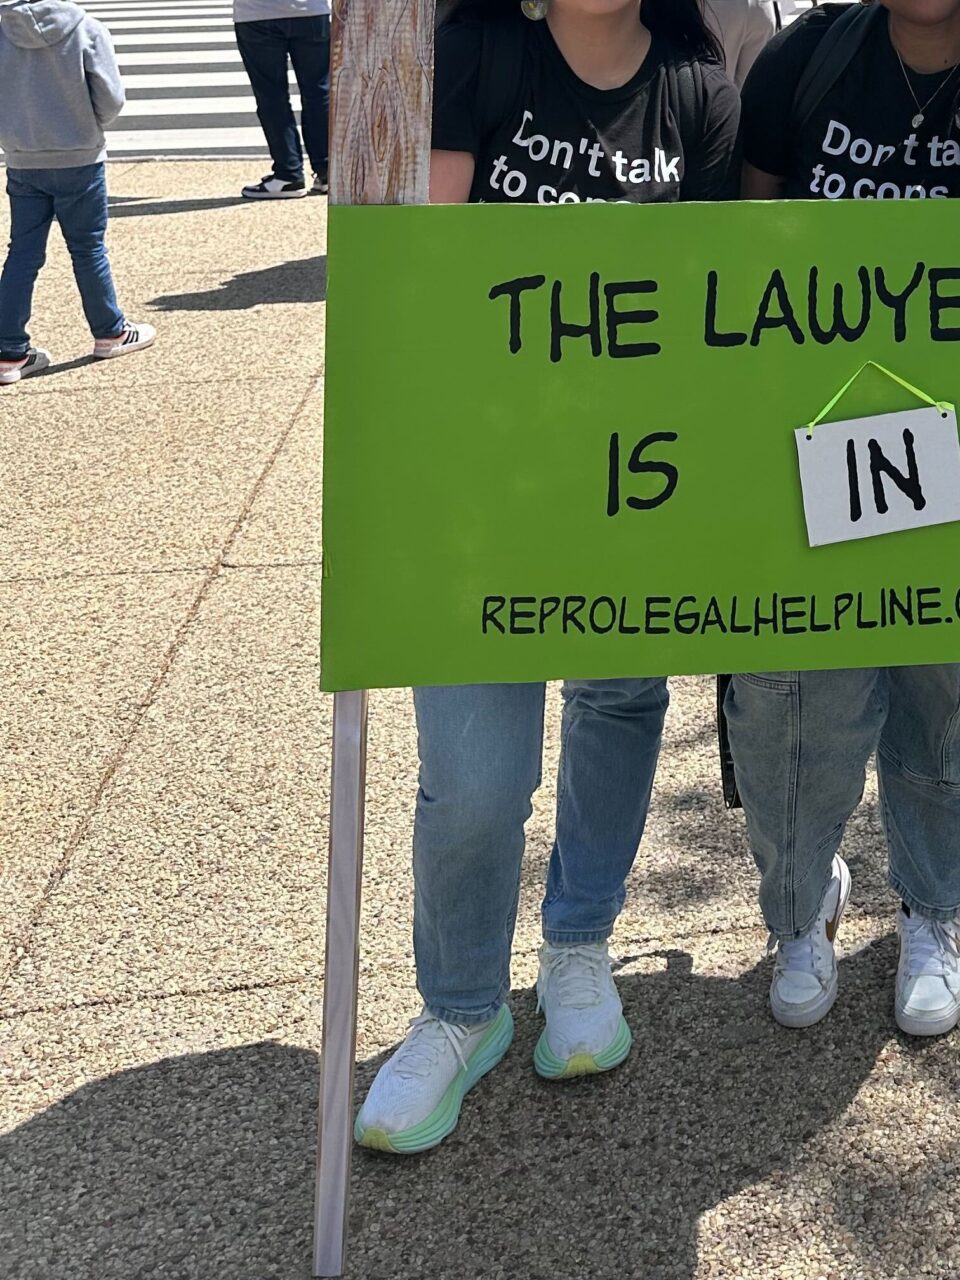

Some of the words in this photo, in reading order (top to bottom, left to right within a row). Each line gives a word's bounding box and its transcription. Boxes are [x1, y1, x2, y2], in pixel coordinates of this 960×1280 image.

[489, 154, 528, 198] to
[536, 184, 633, 204] co
[611, 146, 681, 184] talk
[809, 163, 836, 200] to
[487, 270, 663, 364] THE
[605, 430, 680, 518] IS
[845, 427, 928, 524] IN
